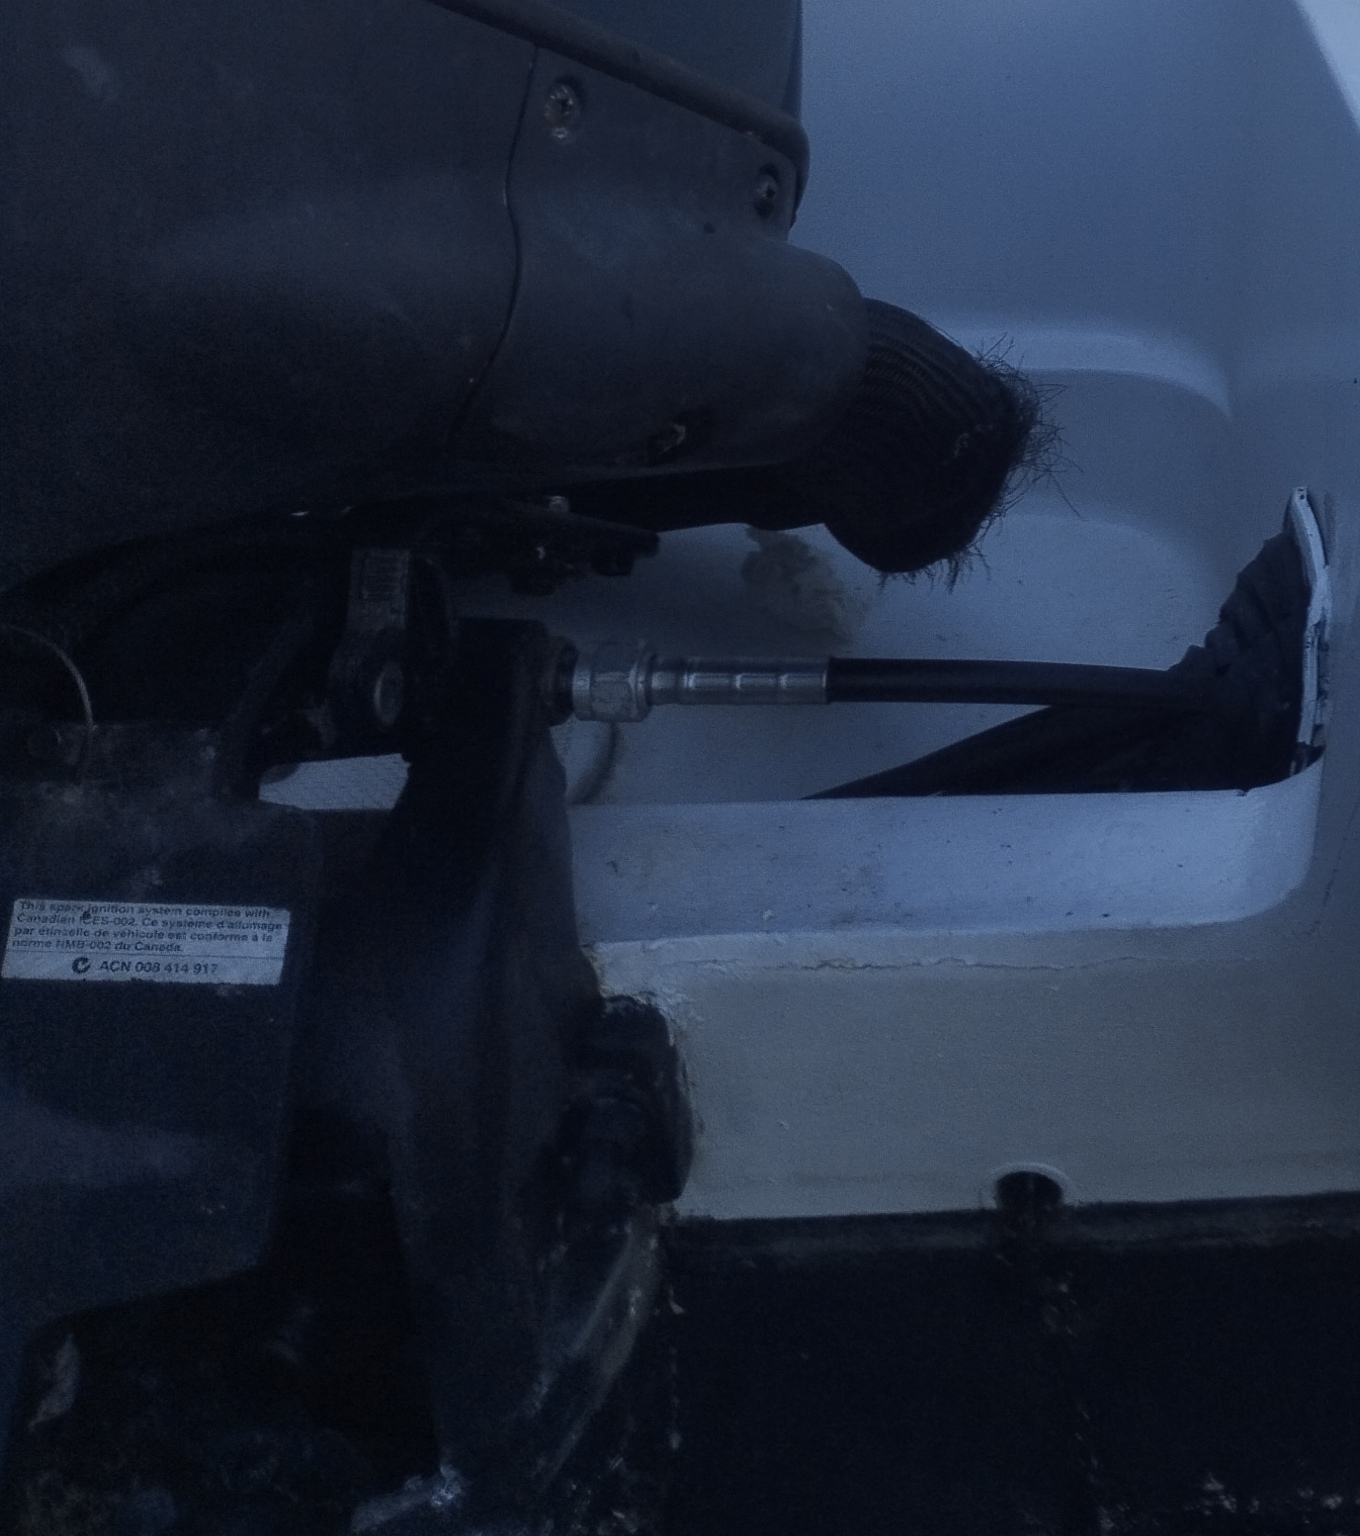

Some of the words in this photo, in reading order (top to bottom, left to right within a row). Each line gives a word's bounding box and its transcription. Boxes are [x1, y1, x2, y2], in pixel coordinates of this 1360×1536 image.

[20, 900, 46, 911] This
[138, 906, 182, 917] system
[186, 907, 241, 918] complies
[245, 909, 270, 918] with
[17, 914, 75, 924] Canadian
[142, 918, 158, 926] Ce
[14, 927, 34, 937] par
[93, 928, 110, 937] de
[190, 931, 248, 941] conforme
[12, 939, 52, 948] norme
[114, 941, 129, 950] du
[99, 960, 131, 972] ACN
[163, 962, 189, 973] 414
[193, 962, 219, 974] 917
